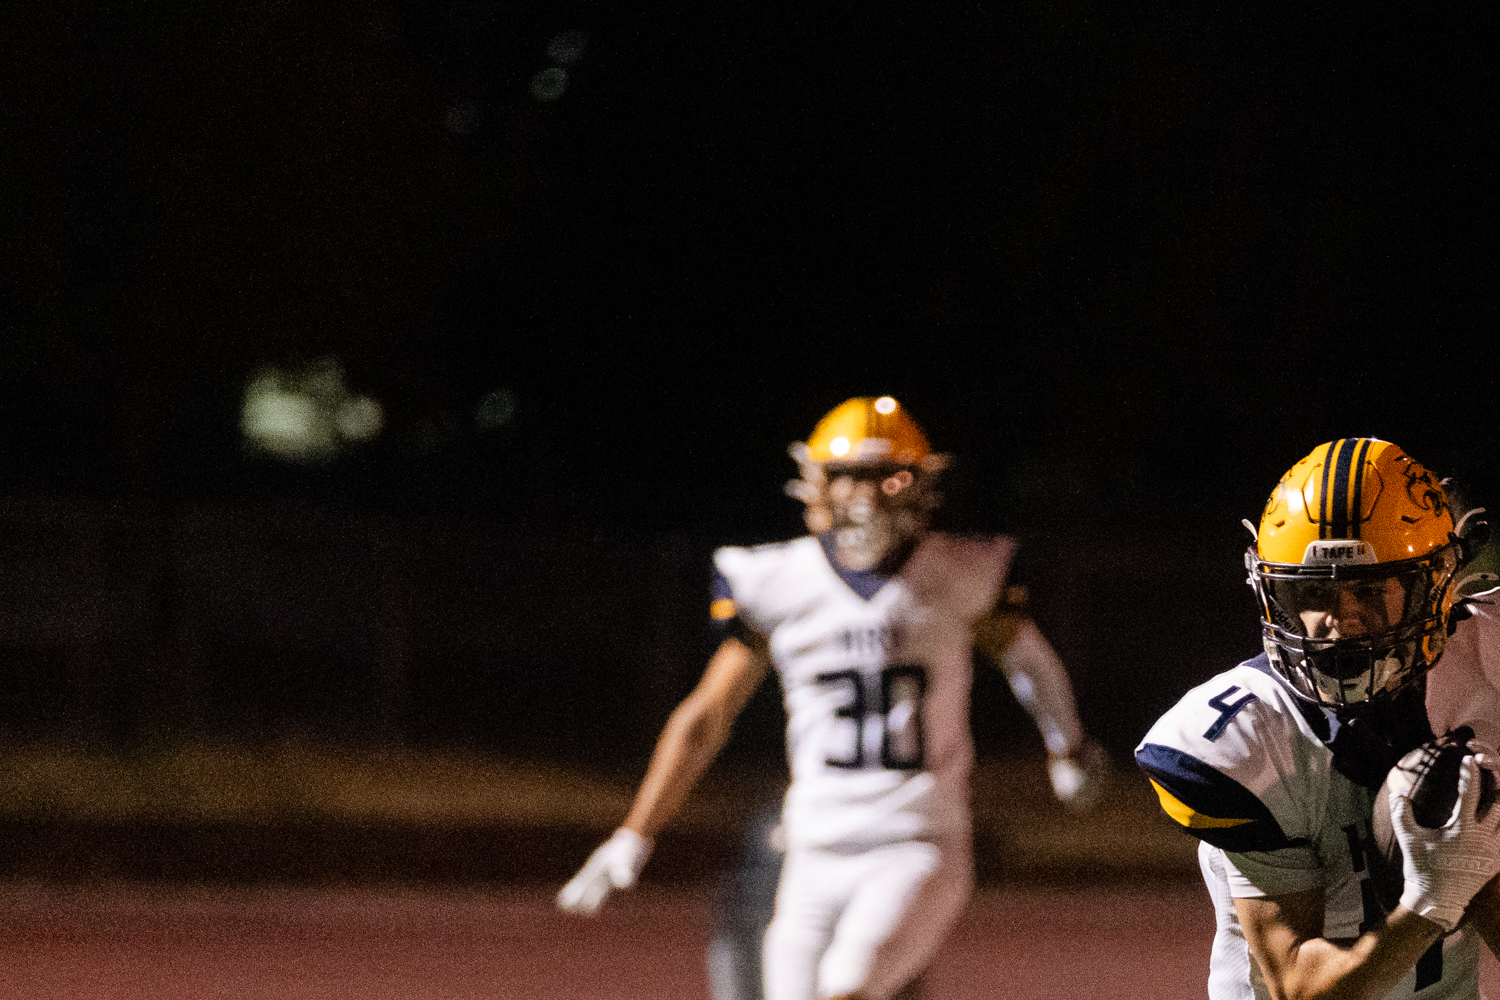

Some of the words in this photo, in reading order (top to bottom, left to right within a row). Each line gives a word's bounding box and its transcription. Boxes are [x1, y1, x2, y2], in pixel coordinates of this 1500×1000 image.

[1321, 546, 1353, 559] TAPE
[812, 665, 927, 772] 30
[1202, 685, 1259, 743] 4
